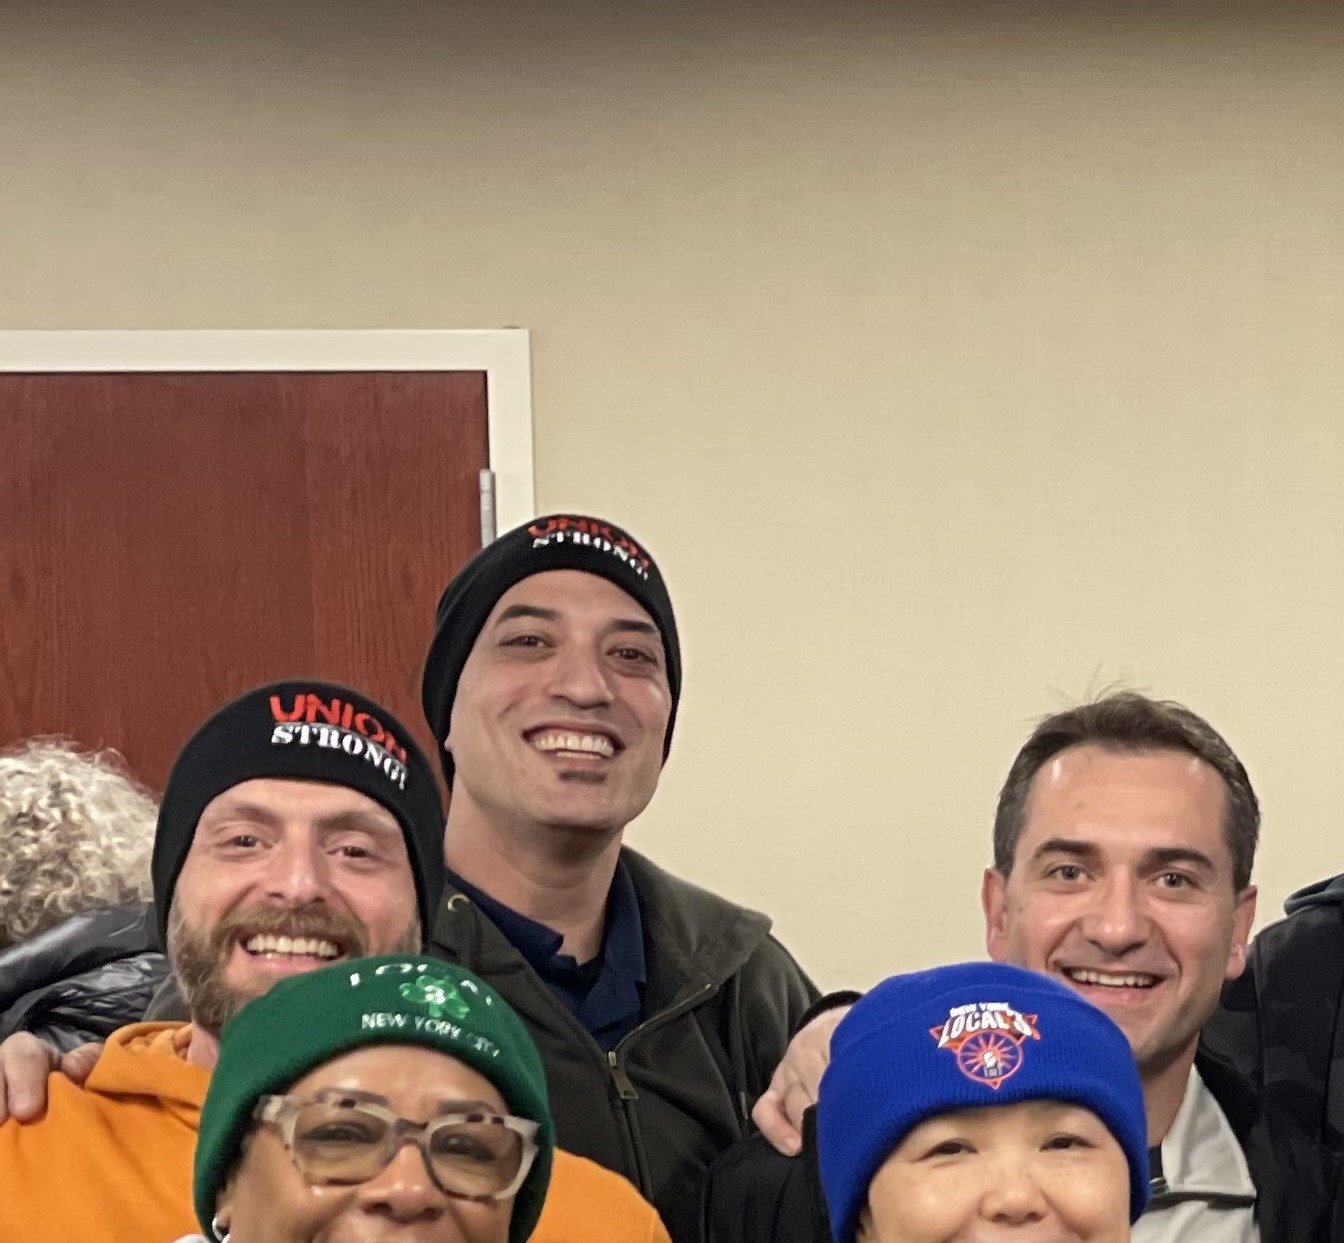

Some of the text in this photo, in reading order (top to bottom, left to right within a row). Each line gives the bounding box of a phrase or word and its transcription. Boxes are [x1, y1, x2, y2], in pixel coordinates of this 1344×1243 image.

[269, 693, 408, 765] UNION
[362, 1012, 408, 1030] NEW
[938, 1010, 1010, 1049] LOCAL
